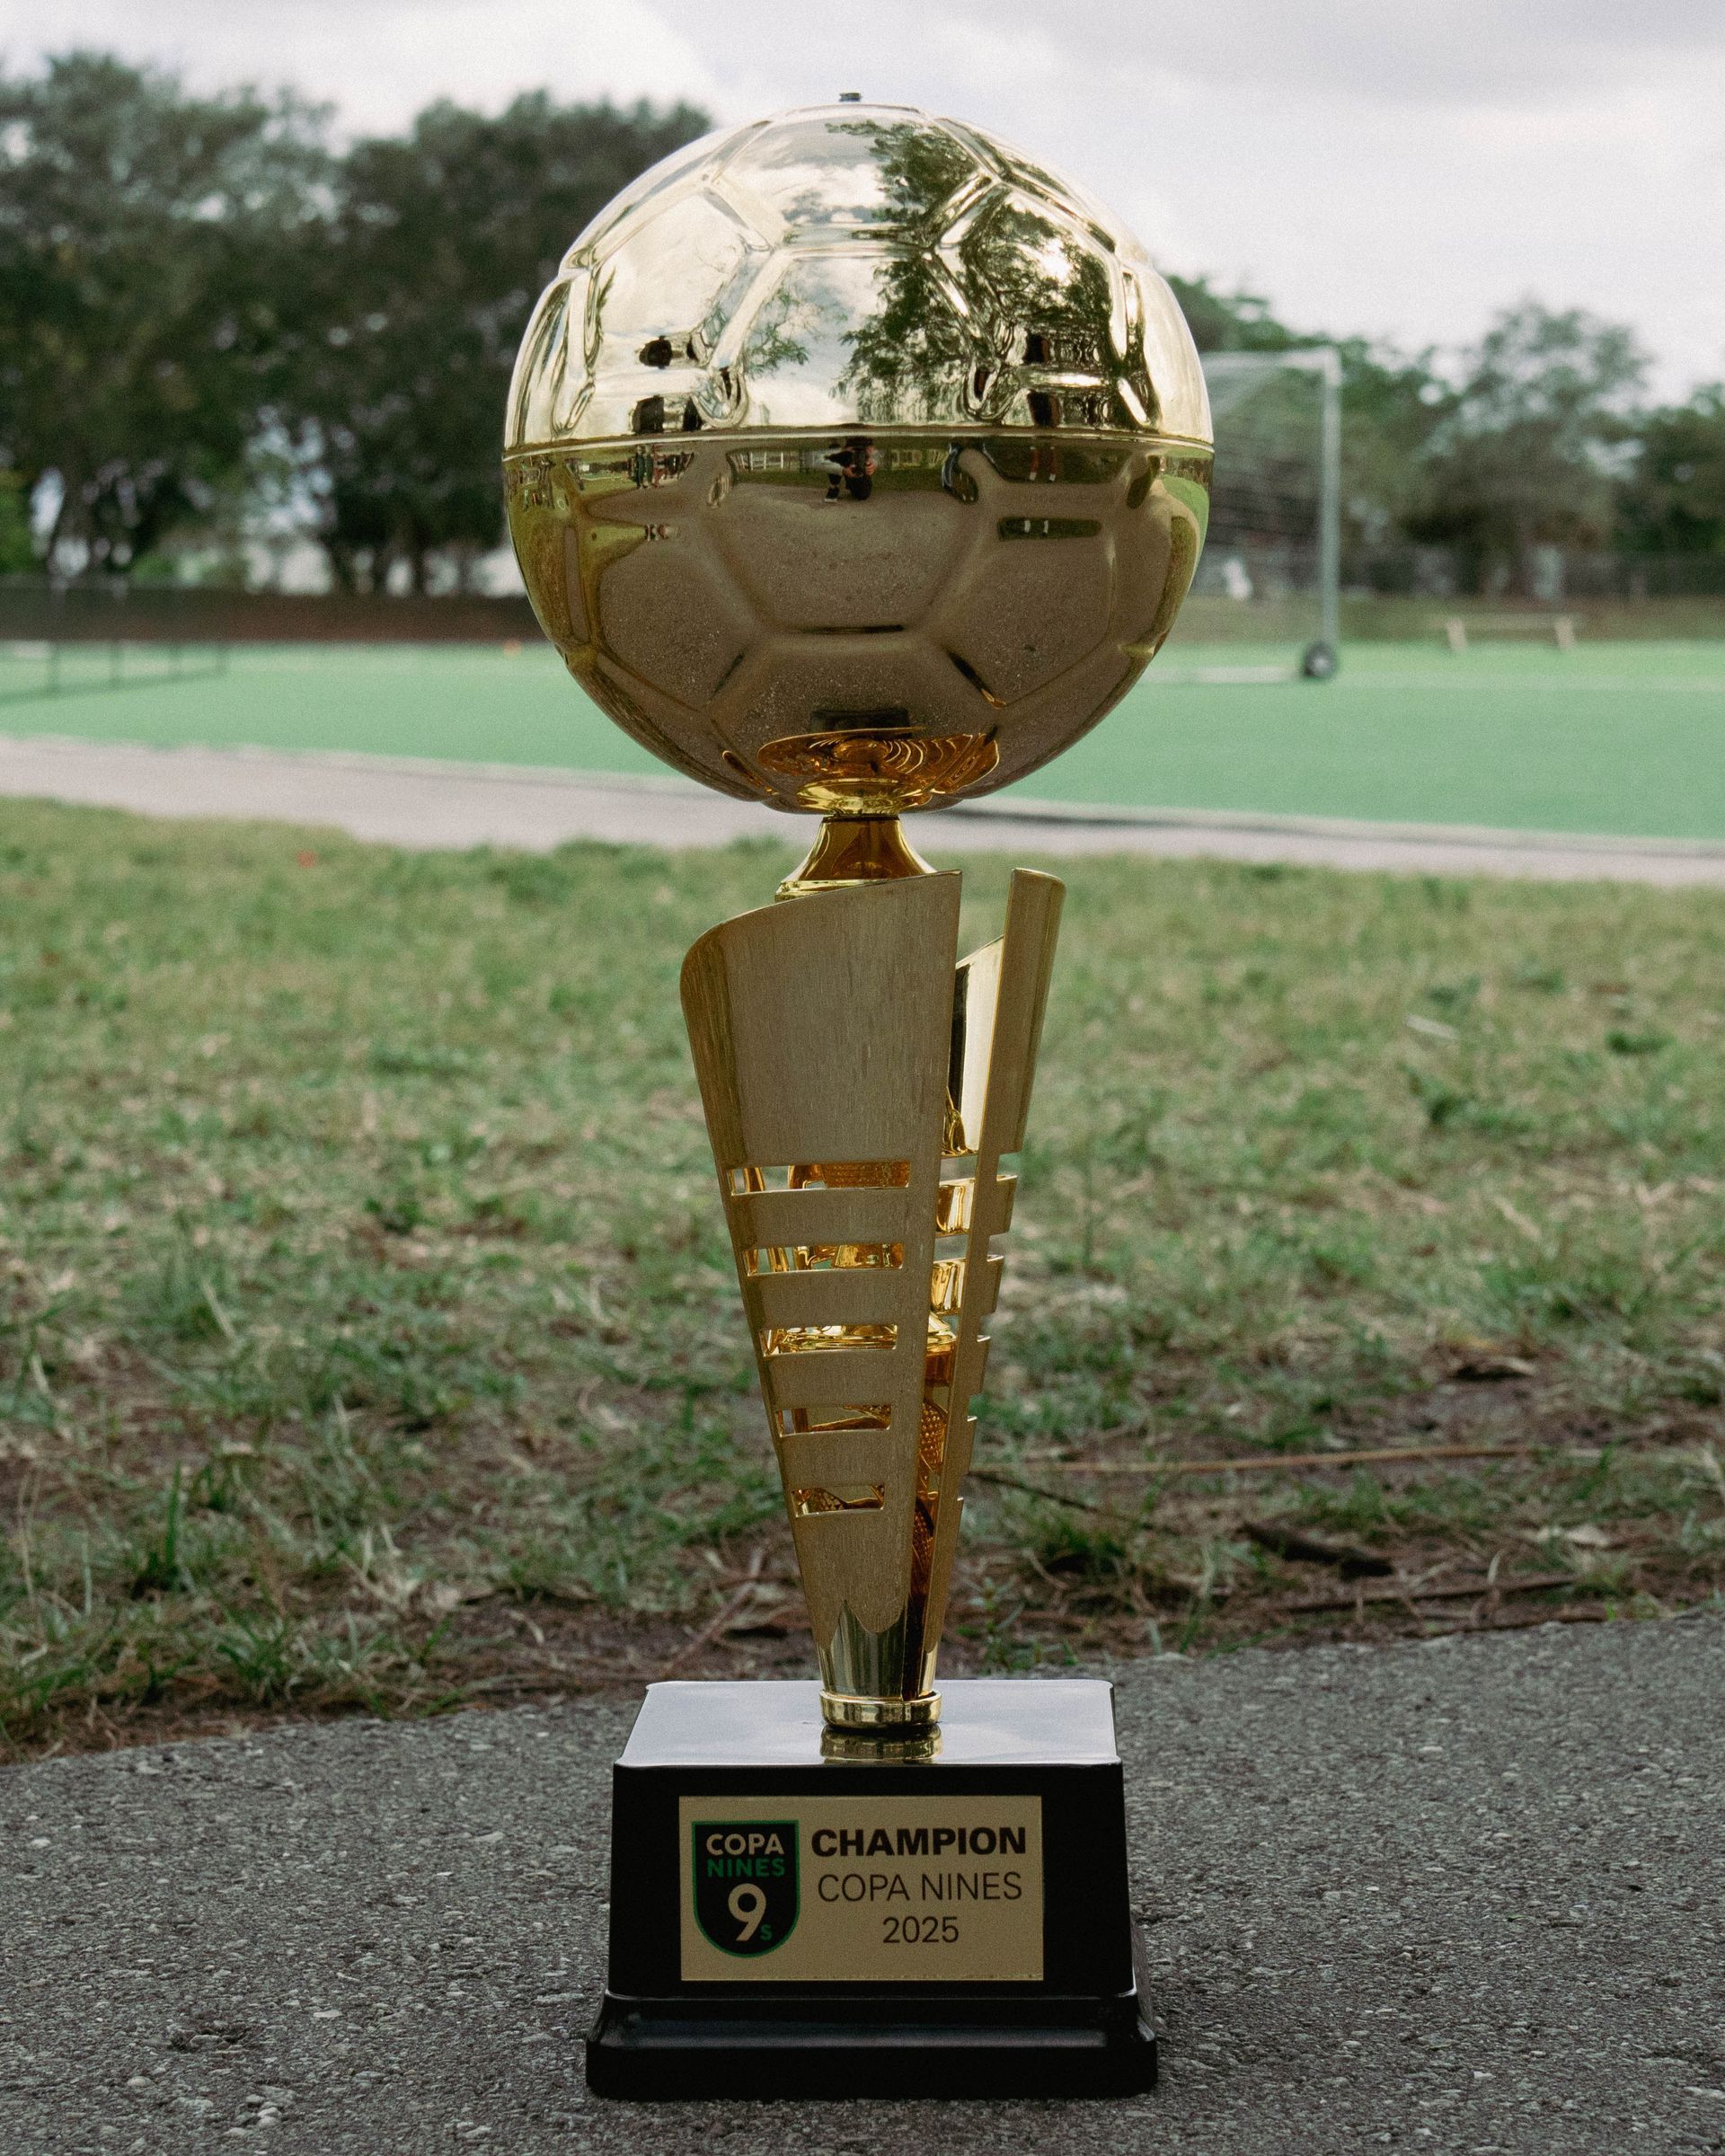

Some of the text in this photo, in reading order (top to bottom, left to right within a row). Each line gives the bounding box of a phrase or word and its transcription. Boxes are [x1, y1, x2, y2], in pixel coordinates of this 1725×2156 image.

[706, 1833, 785, 1856] COPA
[810, 1826, 1027, 1857] CHAMPION
[707, 1858, 786, 1878] NINES
[818, 1871, 1023, 1903] COPA NINES
[882, 1916, 960, 1944] 2025
